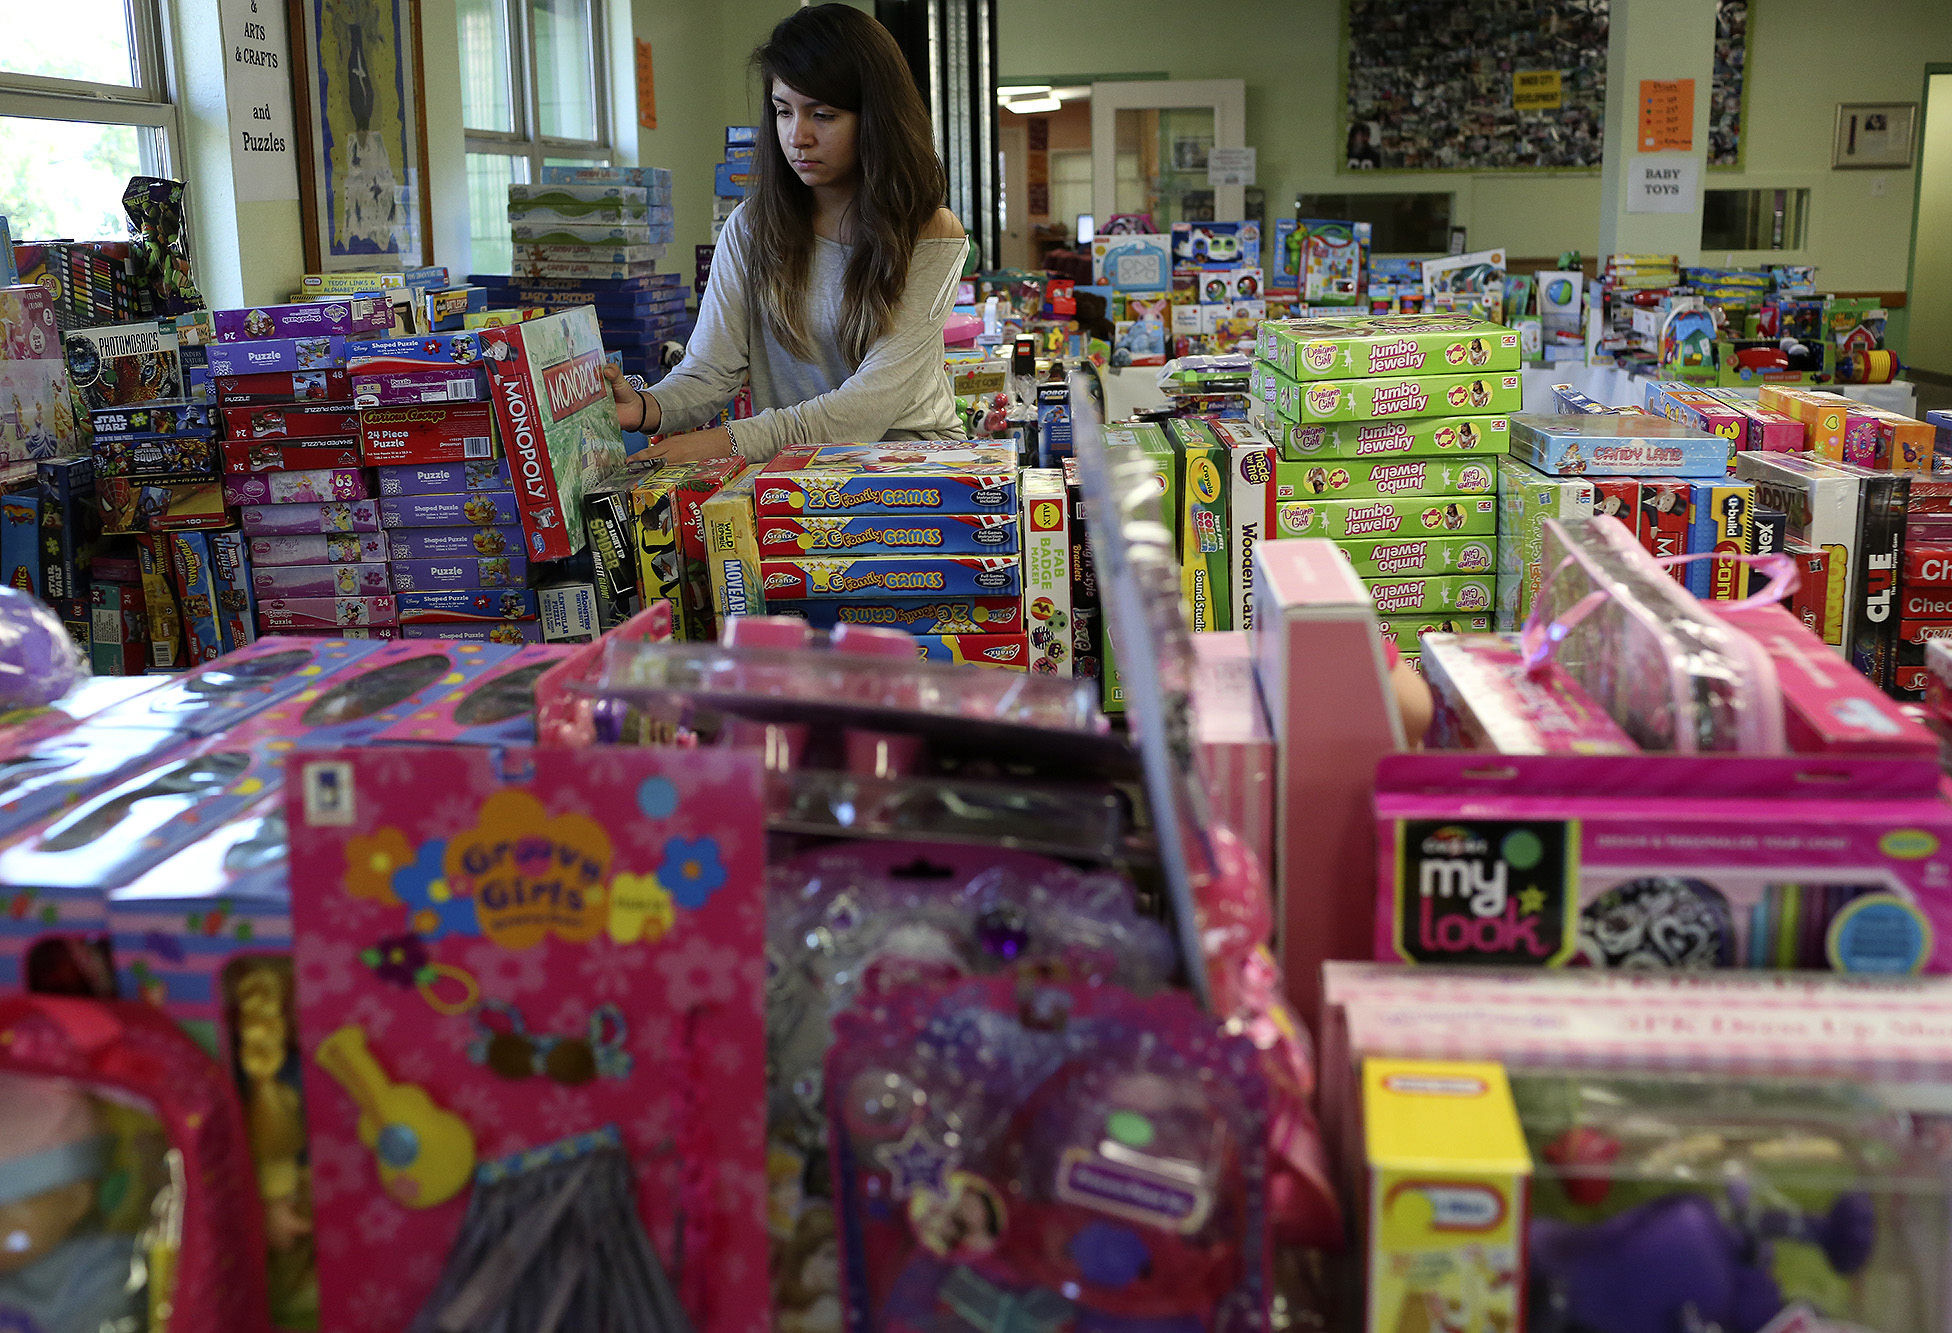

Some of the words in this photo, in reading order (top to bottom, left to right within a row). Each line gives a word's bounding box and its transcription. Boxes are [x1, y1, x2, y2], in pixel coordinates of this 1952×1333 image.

[244, 22, 265, 41] ARTS
[235, 46, 242, 62] &
[243, 48, 279, 69] CRAFTS
[252, 103, 271, 120] and
[242, 131, 286, 152] Puzzles
[1645, 168, 1681, 179] BABY
[1645, 184, 1680, 195] TOYS
[99, 332, 159, 358] PHOTOMOSAICS
[224, 332, 236, 340] 24
[372, 342, 396, 350] Shaped
[1303, 343, 1337, 358] Designer
[1369, 340, 1418, 359] Jumbo
[248, 351, 281, 361] Puzzle
[1314, 353, 1331, 366] Girl
[1369, 352, 1426, 373] Jewelry
[332, 371, 344, 379] 48
[550, 358, 602, 413] MONOPOLY
[1040, 389, 1069, 397] ROBOT
[1308, 387, 1341, 402] Designer
[1372, 382, 1420, 402] Jumbo
[1317, 397, 1335, 410] Girl
[1371, 394, 1428, 416] Jewelry
[94, 415, 127, 423] STAR
[364, 410, 407, 424] Curious
[407, 408, 446, 423] George
[94, 423, 127, 432] WARS
[236, 429, 247, 437] 24
[1292, 426, 1326, 440] Designer
[1359, 422, 1407, 442] Jumbo
[374, 439, 405, 448] Puzzle
[503, 380, 547, 499] MONOPOLY
[1303, 436, 1320, 448] Girl
[1357, 434, 1414, 455] Jewelry
[134, 452, 163, 462] SQUAD
[1246, 454, 1254, 464] by
[1593, 446, 1643, 461] CANDY
[1646, 445, 1684, 461] LAND
[233, 463, 244, 471] 24
[417, 471, 450, 480] Puzzle
[1248, 464, 1261, 485] me!
[1253, 451, 1271, 481] made
[1369, 462, 1426, 481] Jewelry
[335, 474, 353, 487] 63
[1202, 465, 1214, 494] Crayola
[1378, 476, 1426, 494] Jumbo
[1457, 479, 1490, 491] Designer
[1461, 470, 1479, 482] Girl
[841, 488, 882, 506] Family
[882, 488, 943, 507] GAMES
[1578, 488, 1591, 504] MB
[414, 505, 438, 513] Shaped
[1042, 503, 1051, 526] ALEX
[1281, 507, 1315, 521] Designer
[1346, 503, 1394, 522] Jumbo
[1726, 497, 1740, 537] u-build
[1291, 516, 1309, 528] Girl
[1345, 515, 1402, 536] Jewelry
[424, 536, 447, 544] Shaped
[448, 535, 468, 543] Puzzle
[724, 522, 735, 549] WILD
[843, 528, 883, 547] Family
[883, 528, 944, 547] GAMES
[1197, 512, 1207, 552] WONDER
[1204, 512, 1217, 552] COLOR
[589, 519, 620, 570] SPIDER
[608, 529, 621, 549] LIGHT
[617, 549, 626, 559] UP
[1371, 541, 1427, 561] Jewelry
[175, 539, 197, 587] SPIDER-MAN
[214, 538, 234, 581] HEROES
[228, 548, 238, 566] MARVEL
[592, 551, 604, 571] MAKE
[1041, 537, 1053, 591] BADGE
[1054, 549, 1065, 578] FAB
[1073, 544, 1083, 582] Bracelets
[1378, 555, 1426, 573] Jumbo
[1457, 557, 1490, 569] Designer
[1461, 549, 1479, 561] Girl
[431, 566, 462, 576] Puzzle
[1031, 546, 1040, 586] MAKER
[47, 565, 55, 597] STAR
[55, 565, 63, 598] WARS
[769, 577, 793, 585] Grafix
[844, 572, 884, 592] Family
[884, 571, 946, 590] GAMES
[1084, 571, 1095, 597] Style
[1194, 569, 1206, 601] Sound
[1369, 580, 1426, 599] Jewelry
[1866, 553, 1891, 623] CLUE
[92, 591, 99, 602] 24
[124, 594, 131, 604] 24
[378, 599, 389, 607] 24
[1376, 593, 1425, 612] Jumbo
[1455, 596, 1488, 608] Designer
[1461, 589, 1479, 600] Girl
[552, 601, 560, 627] PUZZLE
[558, 592, 568, 634] LENTICULAR
[576, 593, 584, 628] UNIVERSITY
[581, 590, 591, 630] MONSTERS
[840, 608, 897, 623] GAMES
[897, 606, 936, 624] Family
[1194, 602, 1206, 633] Studio
[481, 877, 586, 912] Girls
[1420, 859, 1508, 917] my
[1420, 896, 1550, 957] look
